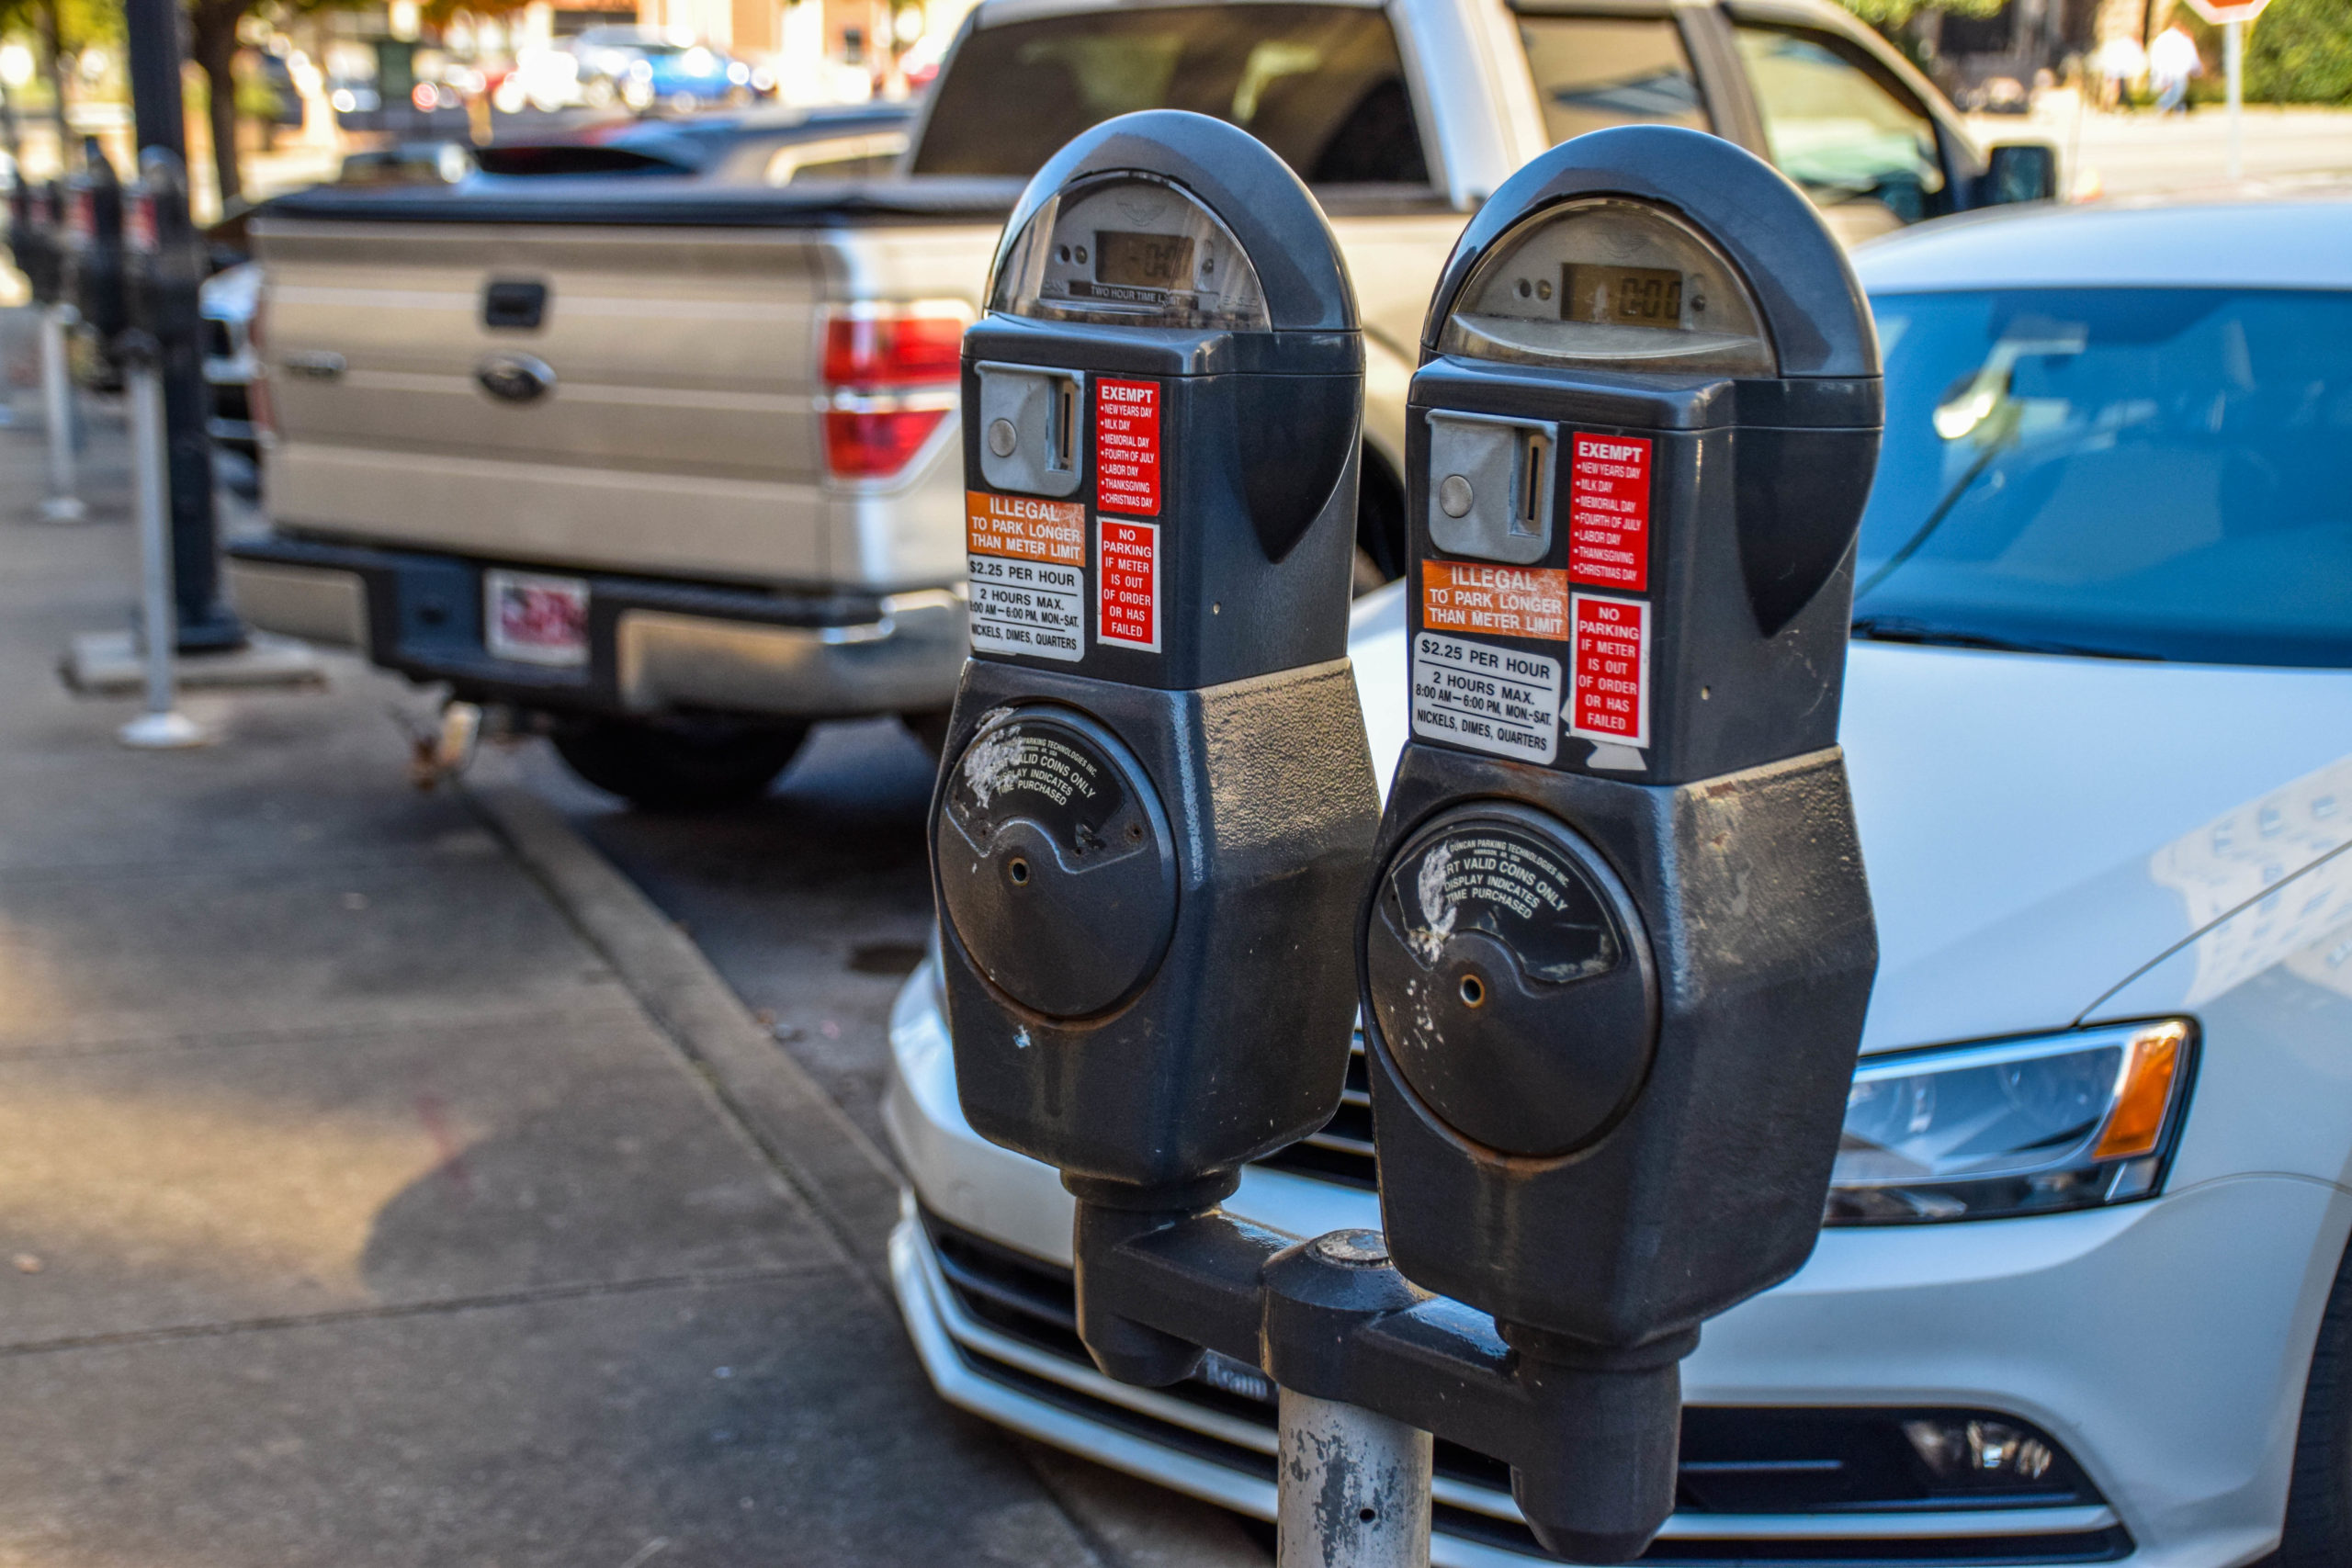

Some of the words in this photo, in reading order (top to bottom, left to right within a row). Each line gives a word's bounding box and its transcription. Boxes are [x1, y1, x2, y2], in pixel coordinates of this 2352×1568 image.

[1091, 285, 1110, 296] TWO
[1111, 288, 1135, 300] HOUR
[1136, 291, 1156, 302] TIME
[1102, 386, 1153, 403] EXEMPT
[1104, 403, 1118, 414] NEW
[1119, 404, 1139, 417] YEARS
[1140, 407, 1152, 418] DAY
[1104, 418, 1117, 430] MLK
[1118, 420, 1130, 431] DAY
[1104, 434, 1136, 446] MEMORIAL
[1137, 436, 1149, 448] DAY
[1104, 448, 1129, 460] FOURTH
[1130, 451, 1139, 462] OF
[1140, 452, 1154, 463] JULY
[1578, 441, 1643, 463] EXEMPT
[1104, 464, 1125, 476] LABOR
[1127, 466, 1138, 477] DAY
[1581, 461, 1599, 474] NEW
[1600, 464, 1624, 478] YEARS
[1625, 467, 1641, 479] DAY
[1104, 478, 1150, 493] THANKSGIVING
[1580, 479, 1597, 491] MLK
[1599, 480, 1613, 493] DAY
[1105, 492, 1140, 507] CHRISTMAS
[1141, 497, 1153, 507] DAY
[1580, 495, 1620, 512] MEMORIAL
[1621, 500, 1636, 513] DAY
[989, 497, 1060, 522] ILLEGAL
[972, 516, 988, 531] TO
[992, 519, 1023, 535] PARK
[1029, 524, 1081, 542] LONGER
[1579, 513, 1610, 527] FOURTH
[1611, 516, 1623, 528] OF
[1623, 518, 1642, 531] JULY
[1119, 529, 1136, 541] NO
[1579, 529, 1605, 543] LABOR
[1606, 533, 1622, 546] DAY
[972, 533, 1001, 549] THAN
[1006, 537, 1046, 555] METER
[1051, 543, 1080, 559] LIMIT
[1103, 540, 1152, 558] PARKING
[1578, 546, 1634, 565] THANKSGIVING
[969, 560, 1002, 577] $2.25
[1009, 566, 1033, 581] PER
[1039, 570, 1075, 586] HOUR
[1105, 557, 1114, 568] IF
[1118, 558, 1149, 573] METER
[1578, 562, 1622, 580] CHRISTMAS
[1623, 569, 1637, 581] DAY
[1111, 574, 1121, 586] IS
[1125, 576, 1143, 589] OUT
[1452, 566, 1537, 592] ILLEGAL
[980, 588, 987, 600] 2
[992, 590, 1031, 605] HOURS
[1036, 596, 1065, 611] MAX.
[1103, 589, 1115, 601] OF
[1119, 591, 1151, 606] ORDER
[1430, 588, 1448, 604] TO
[1454, 591, 1493, 608] PARK
[1499, 594, 1562, 615] LONGER
[985, 603, 996, 615] AM
[1006, 606, 1023, 620] 6:00
[1109, 605, 1122, 618] OR
[1126, 608, 1145, 622] HAS
[1430, 607, 1465, 625] THAN
[1472, 611, 1520, 629] METER
[1526, 616, 1563, 634] LIMIT
[1599, 607, 1620, 621] NO
[1112, 622, 1143, 637] FAILED
[1578, 620, 1639, 640] PARKING
[1006, 629, 1033, 645] DIMES,
[1036, 633, 1077, 650] QUARTERS
[1581, 638, 1592, 651] IF
[1597, 640, 1635, 658] METER
[1421, 639, 1463, 660] $2.25
[1470, 649, 1498, 669] PER
[1506, 658, 1550, 680] HOUR
[1588, 658, 1600, 671] IS
[1605, 660, 1628, 675] OUT
[1433, 671, 1442, 684] 2
[1447, 674, 1496, 696] HOURS
[1501, 686, 1535, 705] MAX.
[1578, 674, 1593, 688] OF
[1598, 678, 1637, 695] ORDER
[1416, 683, 1436, 699] 8:00
[1438, 689, 1452, 703] AM
[1463, 694, 1484, 710] 6:00
[1585, 694, 1601, 707] OR
[1606, 698, 1630, 713] HAS
[1417, 709, 1458, 732] NICKELS,
[1462, 719, 1493, 740] DIMES,
[1498, 728, 1547, 751] QUARTERS
[1587, 712, 1626, 730] FAILED
[1047, 739, 1088, 767] TECHNOLOGIES
[1018, 753, 1038, 764] ALID
[1040, 755, 1070, 776] COINS
[1070, 772, 1096, 798] ONLY
[1030, 768, 1073, 796] INDICATES
[1017, 780, 1067, 806] PURCHASED
[1450, 840, 1476, 852] DUNCAN
[1476, 839, 1507, 851] PARKING
[1508, 842, 1557, 875] TECHNOLOGIES
[1444, 874, 1484, 892] DISPLAY
[1487, 875, 1541, 908] INDICATES
[1464, 857, 1497, 871] VALID
[1498, 861, 1537, 886] COINS
[1536, 881, 1569, 912] ONLY
[1446, 888, 1468, 904] TIME
[1471, 886, 1532, 919] PURCHASED
